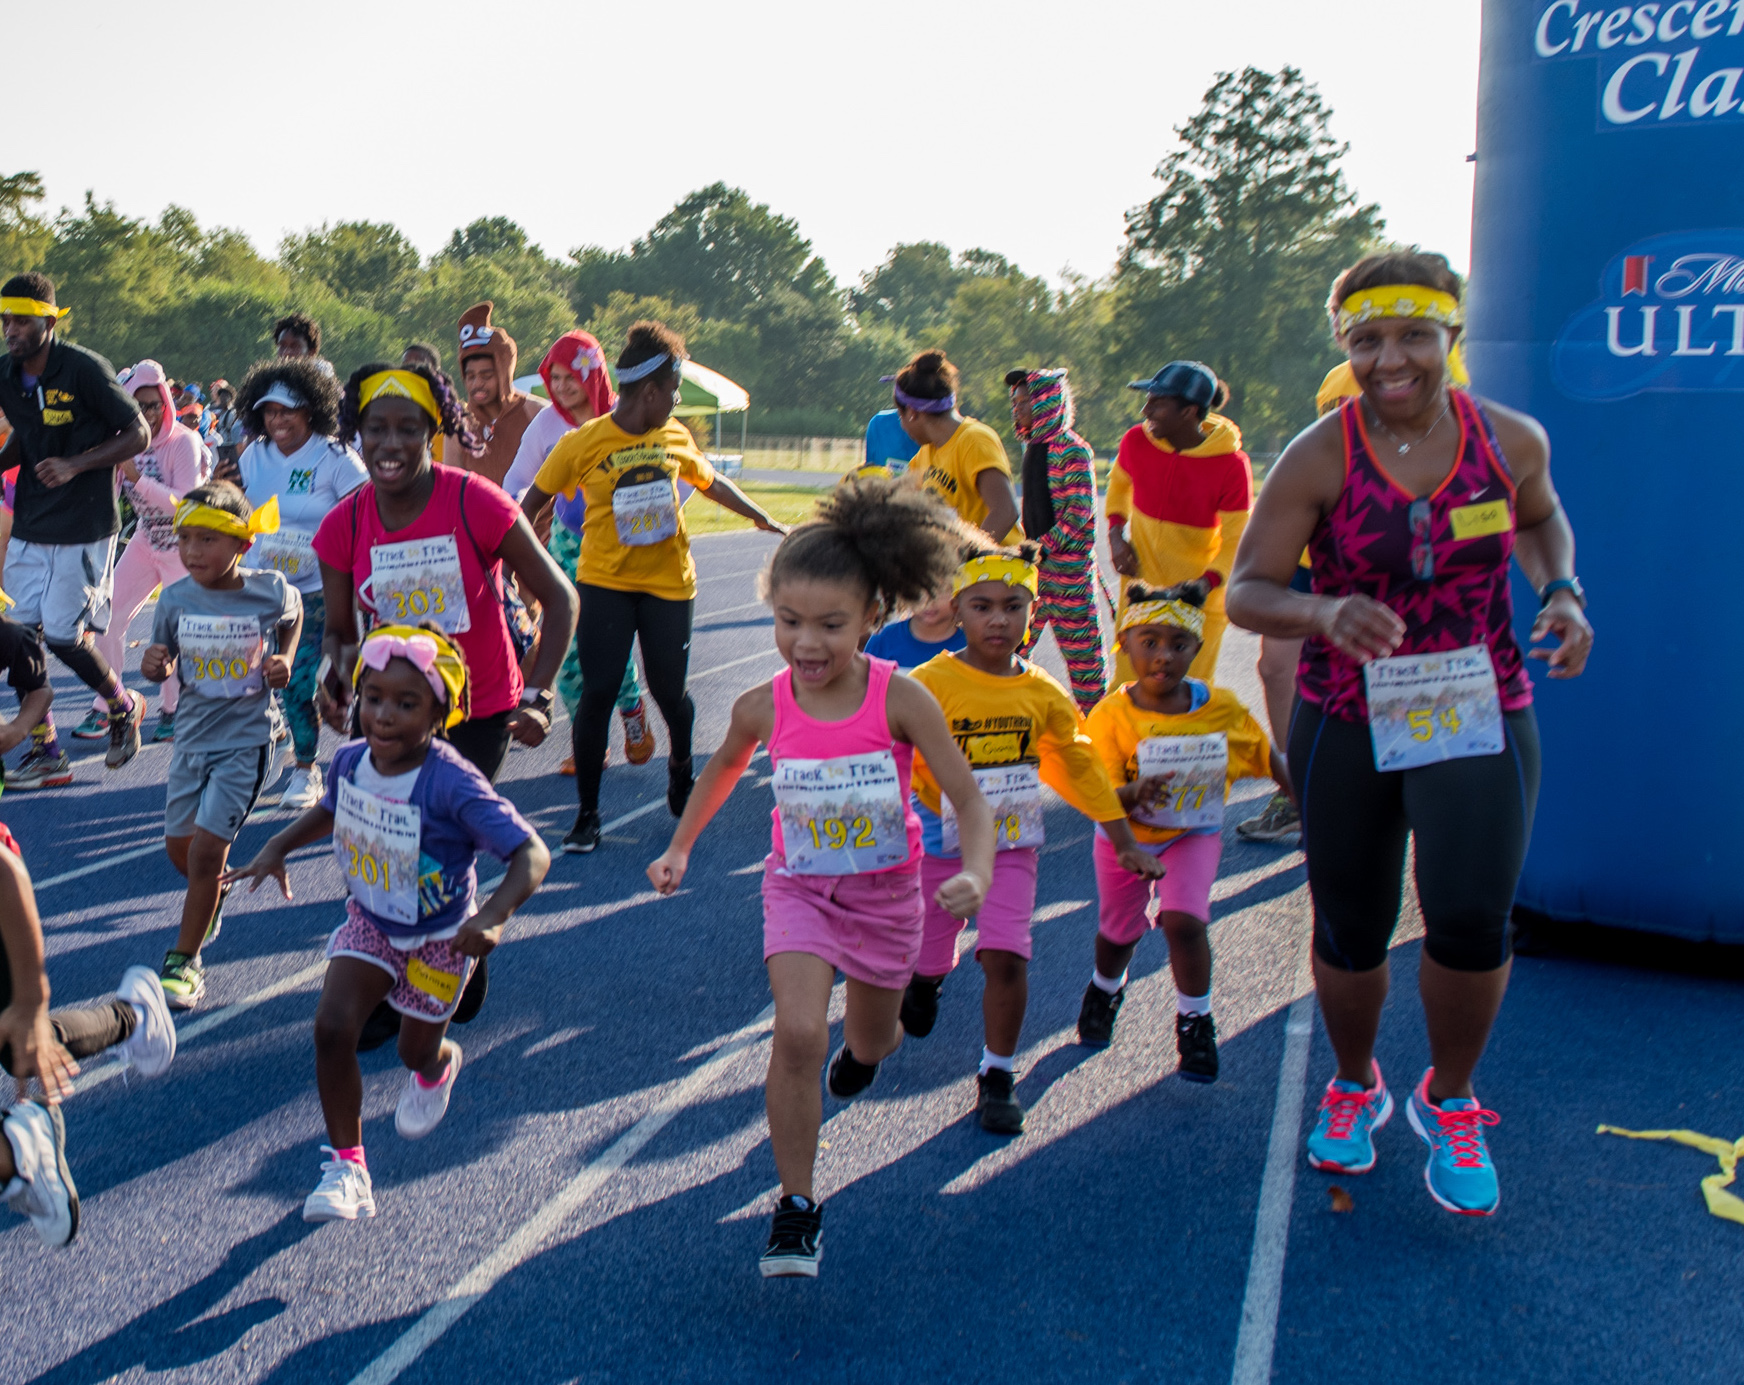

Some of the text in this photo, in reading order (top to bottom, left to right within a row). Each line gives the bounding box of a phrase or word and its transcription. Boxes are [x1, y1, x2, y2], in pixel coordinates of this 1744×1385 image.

[1602, 46, 1744, 125] Cla
[631, 513, 661, 535] 281
[392, 586, 446, 619] 303
[193, 656, 249, 680] 300
[1406, 706, 1462, 743] 54
[808, 816, 877, 850] 192
[349, 843, 390, 893] 301
